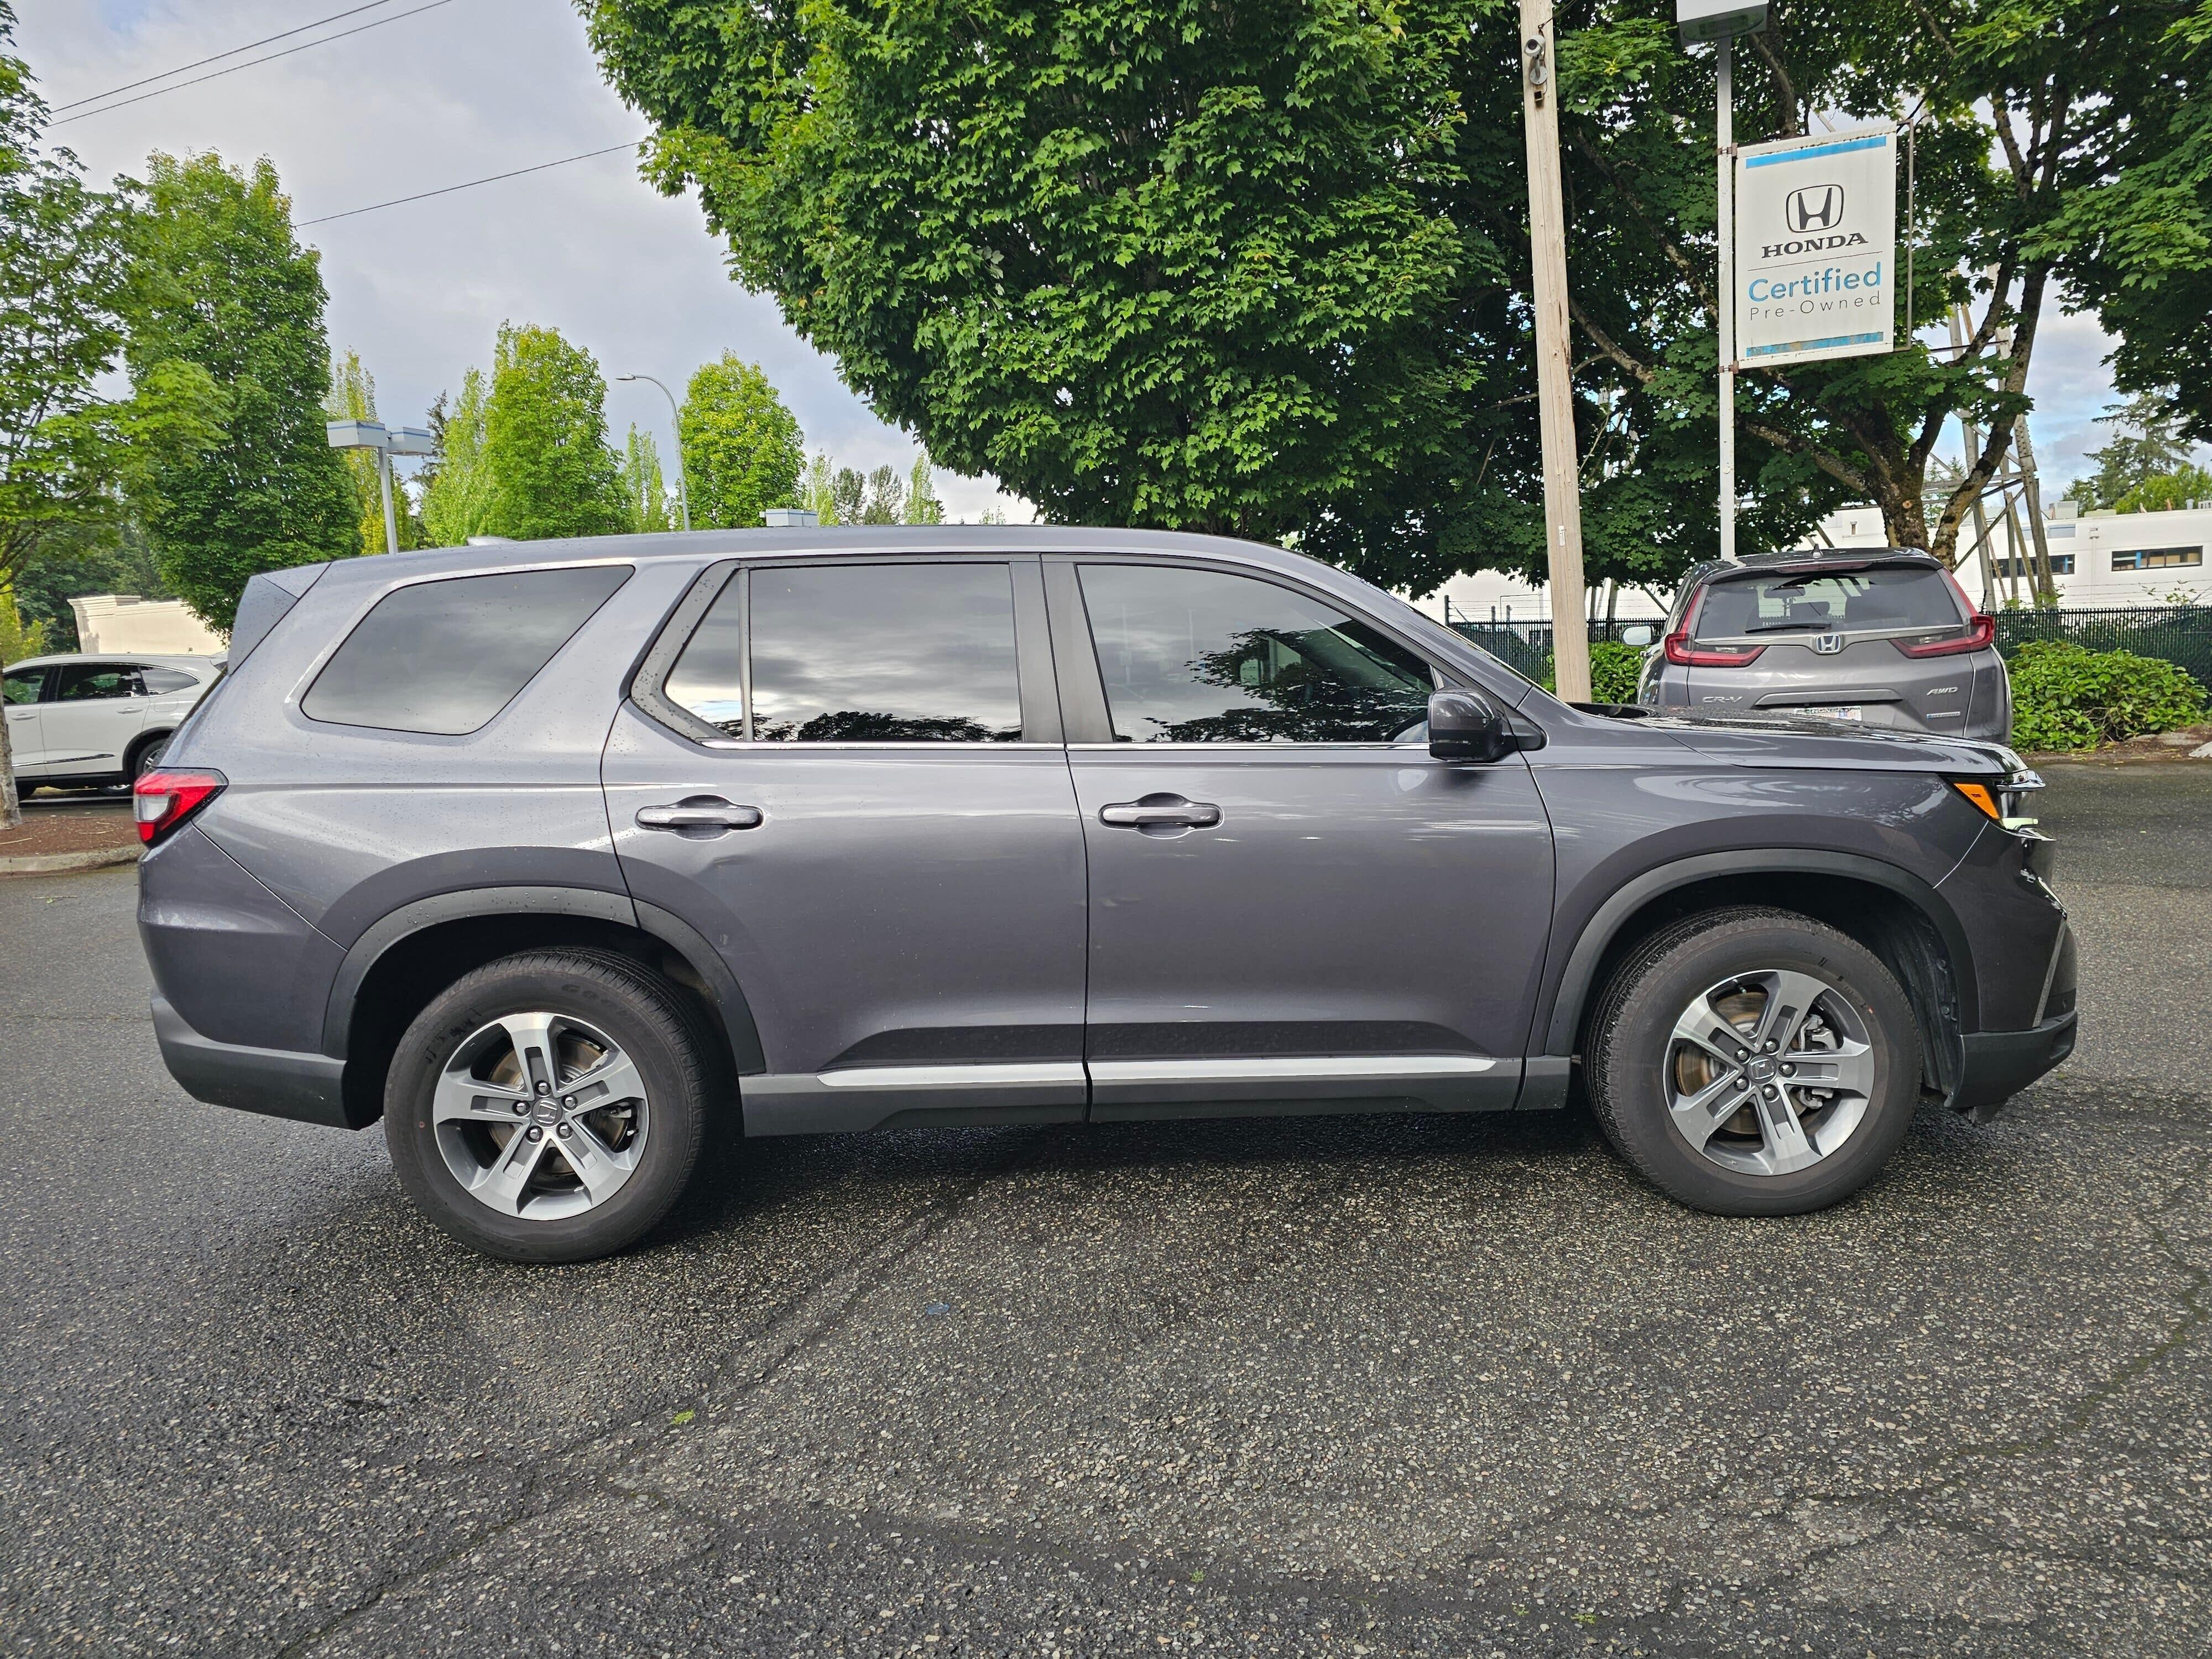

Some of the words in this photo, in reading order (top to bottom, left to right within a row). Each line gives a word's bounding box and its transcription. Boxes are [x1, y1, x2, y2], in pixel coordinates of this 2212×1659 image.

[1761, 232, 1869, 259] HONDA
[1748, 261, 1881, 302] Certified
[1750, 290, 1881, 321] Pre-Owned
[1702, 696, 1743, 704] CR-V
[1926, 687, 1959, 696] AWD
